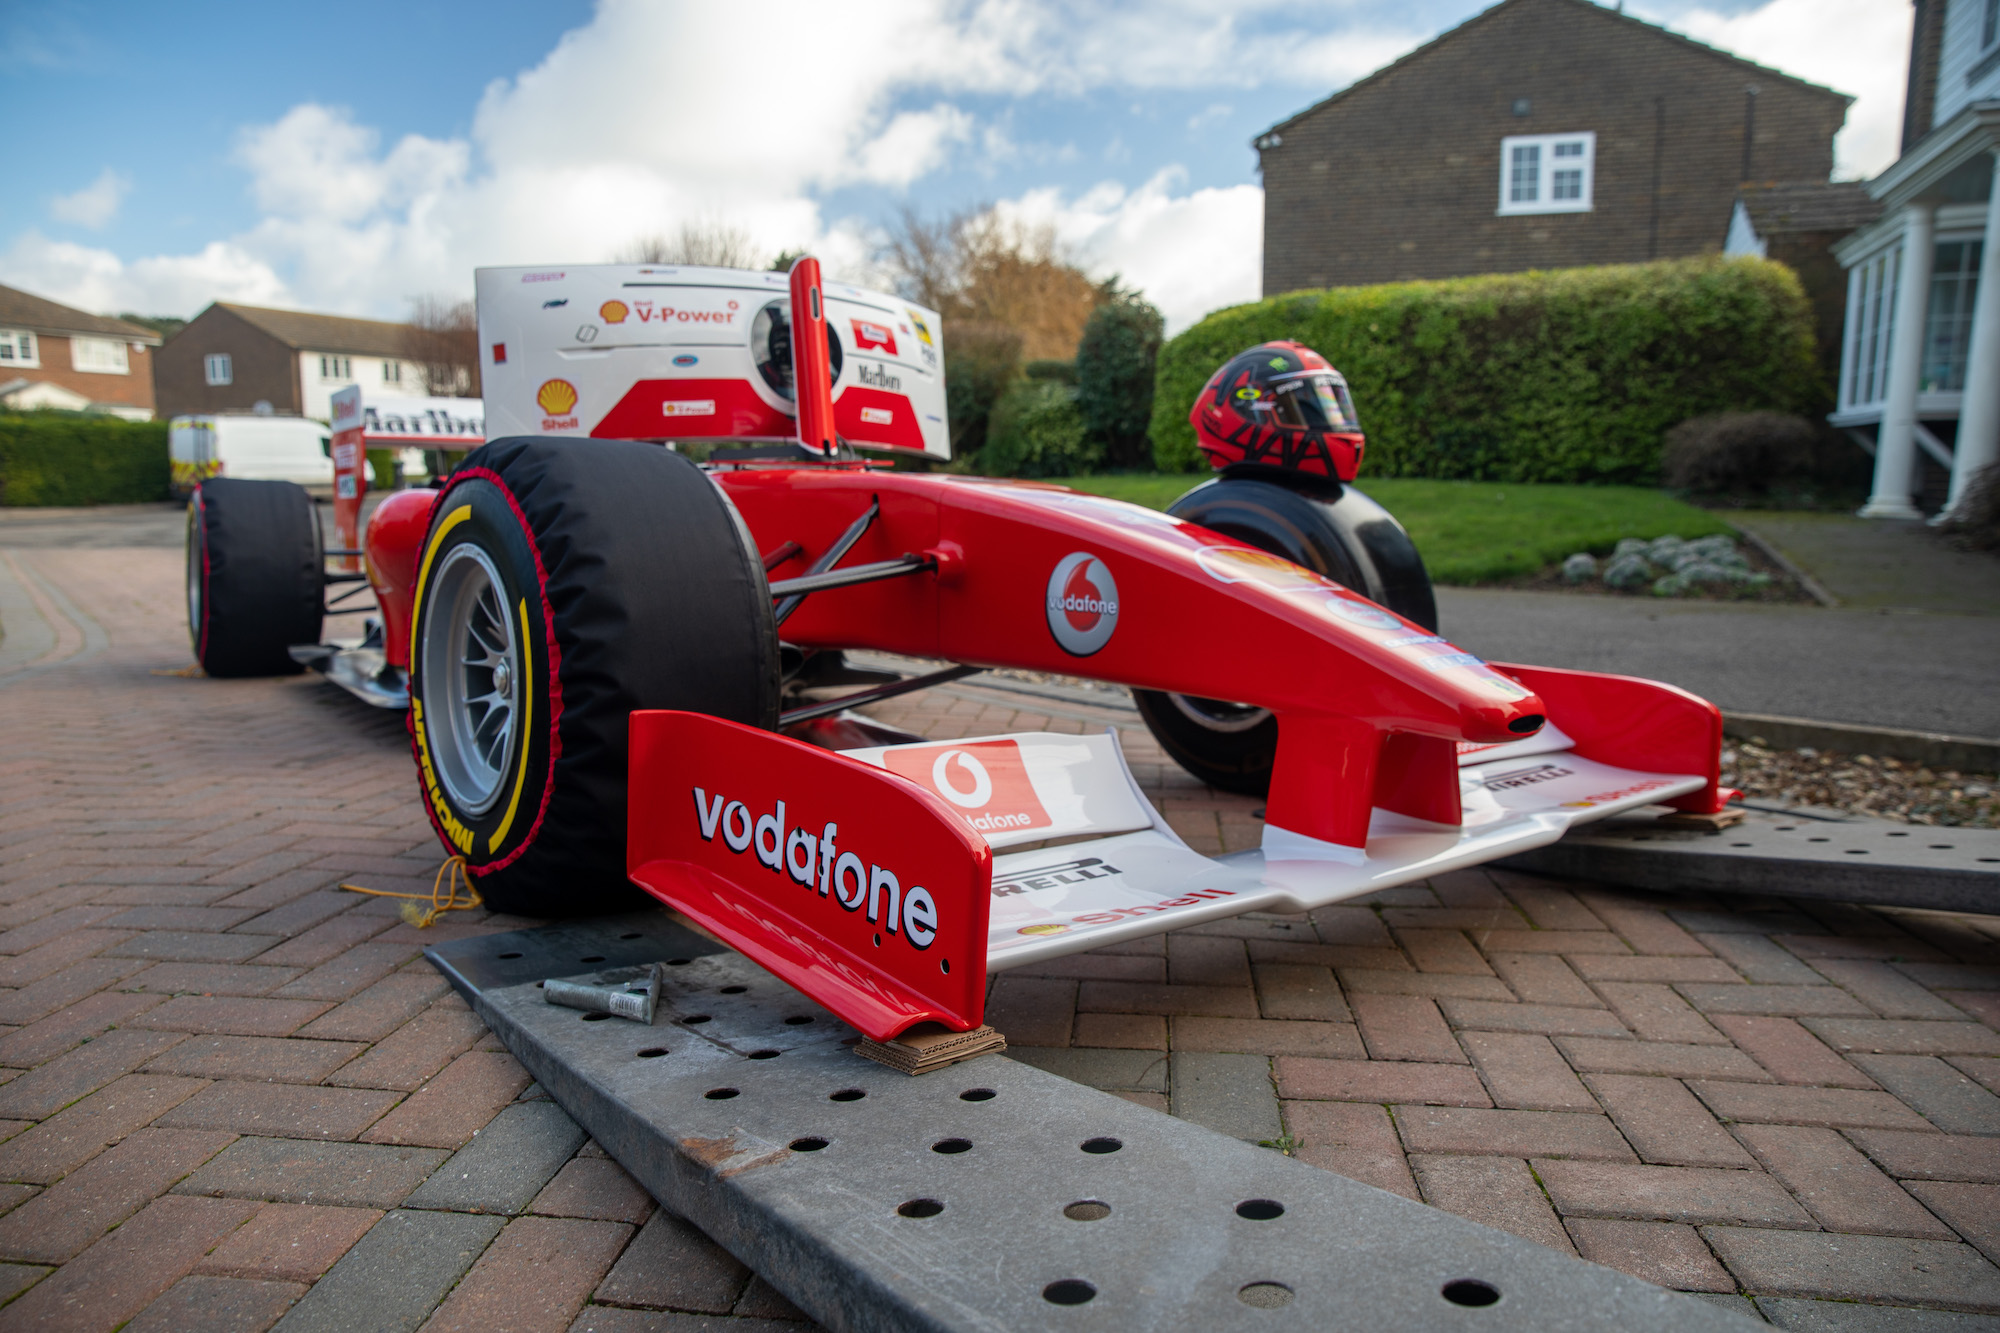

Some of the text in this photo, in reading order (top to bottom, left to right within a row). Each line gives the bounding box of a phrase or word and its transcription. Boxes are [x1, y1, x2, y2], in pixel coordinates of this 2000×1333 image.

[636, 307, 734, 323] V-Power
[541, 417, 578, 431] Shell
[1049, 594, 1117, 615] vodafone
[692, 787, 938, 950] vodafone
[992, 857, 1123, 898] RELLI
[1072, 889, 1238, 924] Shell
